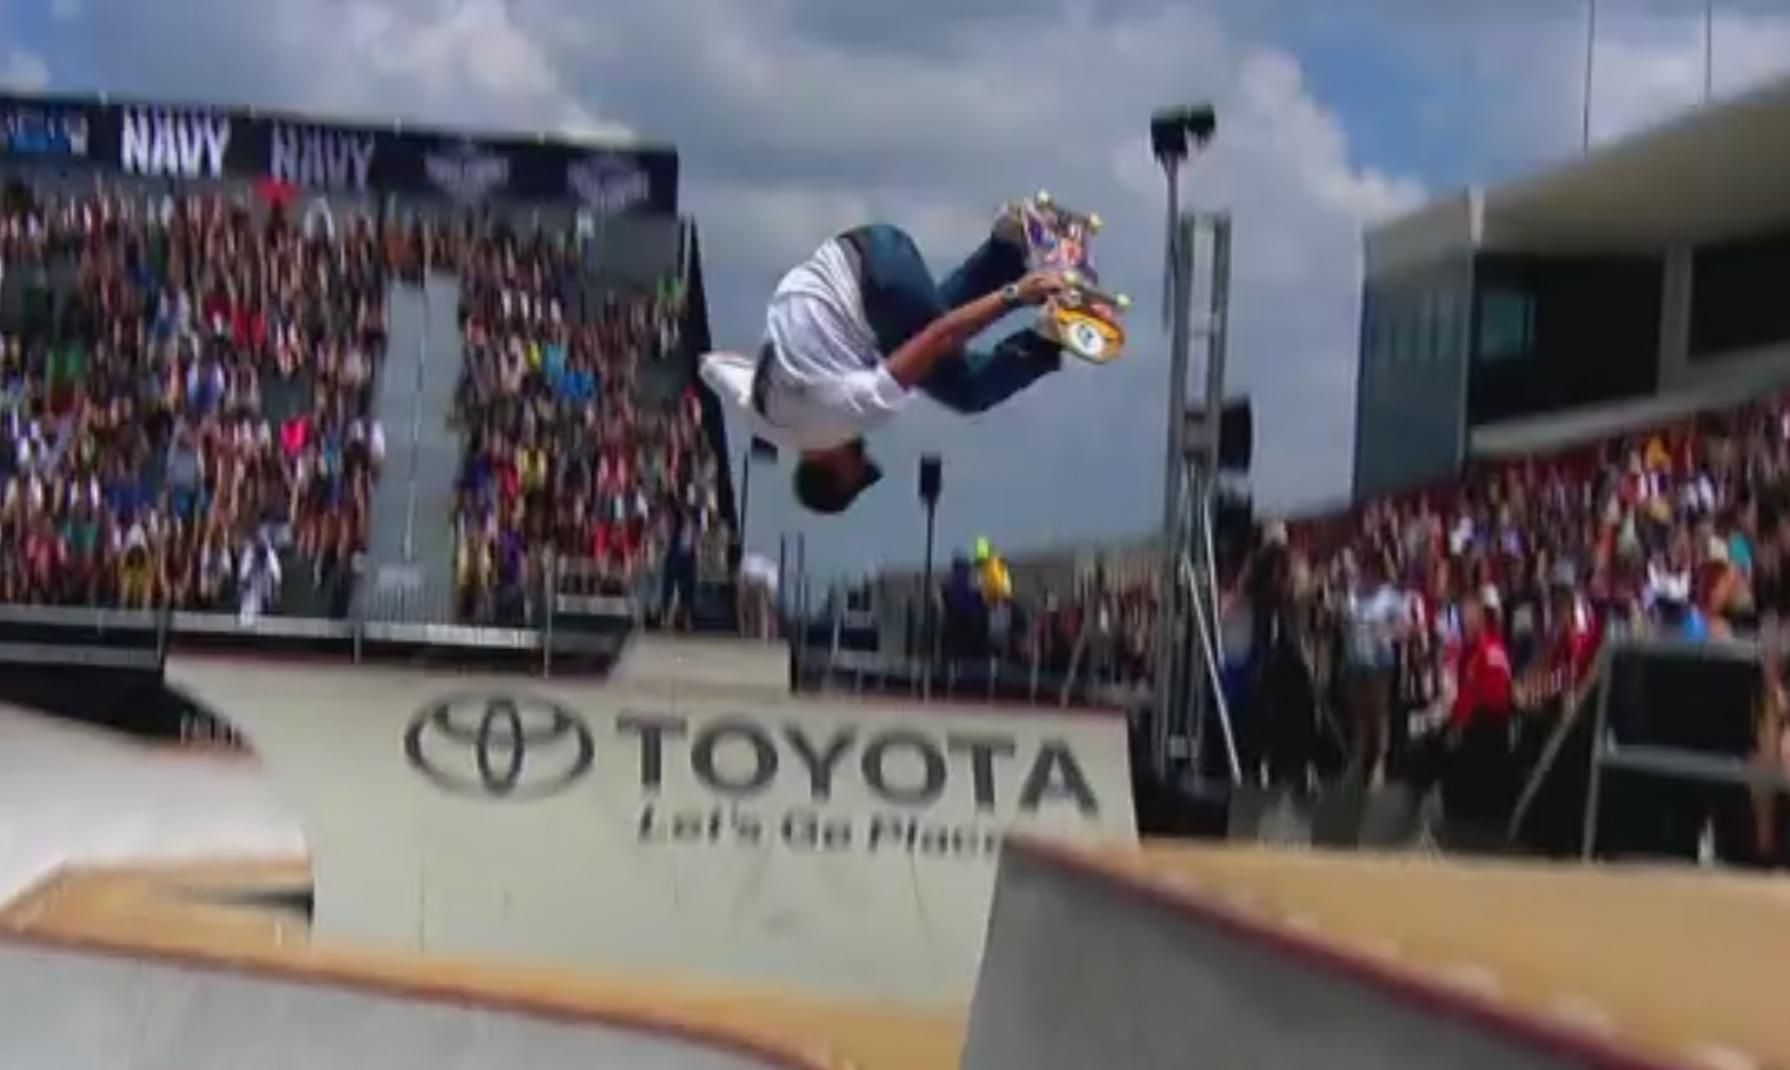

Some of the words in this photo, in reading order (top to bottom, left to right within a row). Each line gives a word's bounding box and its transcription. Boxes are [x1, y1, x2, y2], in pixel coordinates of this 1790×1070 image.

[120, 103, 231, 178] NAVY
[270, 123, 377, 191] NAVY
[616, 713, 1098, 815] TOYOTA
[638, 801, 760, 846] Let's
[781, 810, 852, 850] Go
